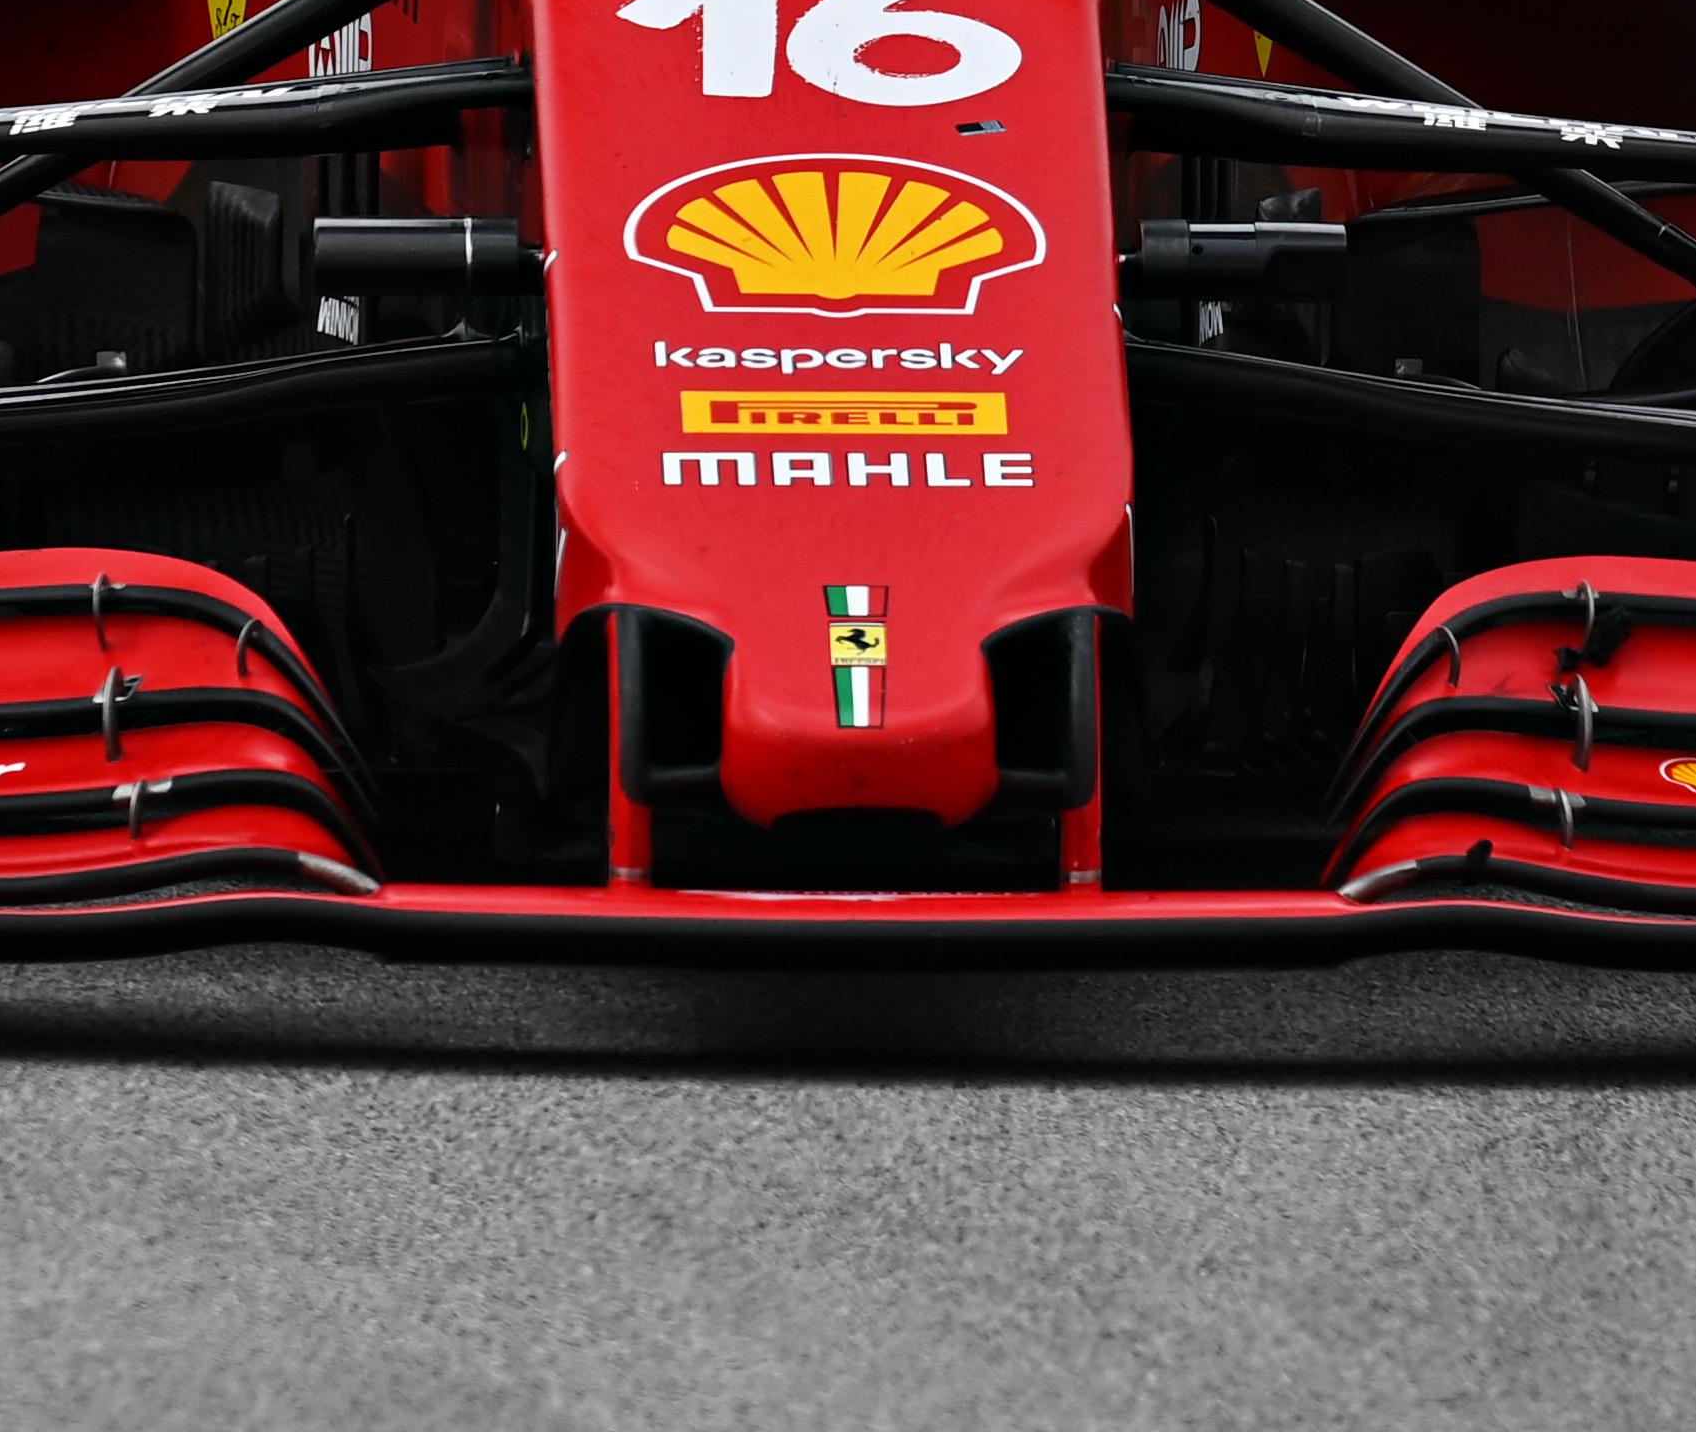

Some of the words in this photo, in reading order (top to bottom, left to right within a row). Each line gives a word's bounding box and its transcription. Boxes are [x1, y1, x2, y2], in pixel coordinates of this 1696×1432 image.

[654, 340, 1024, 374] kaspersky
[709, 400, 978, 426] PIRELLI
[661, 451, 1035, 487] MAHLE
